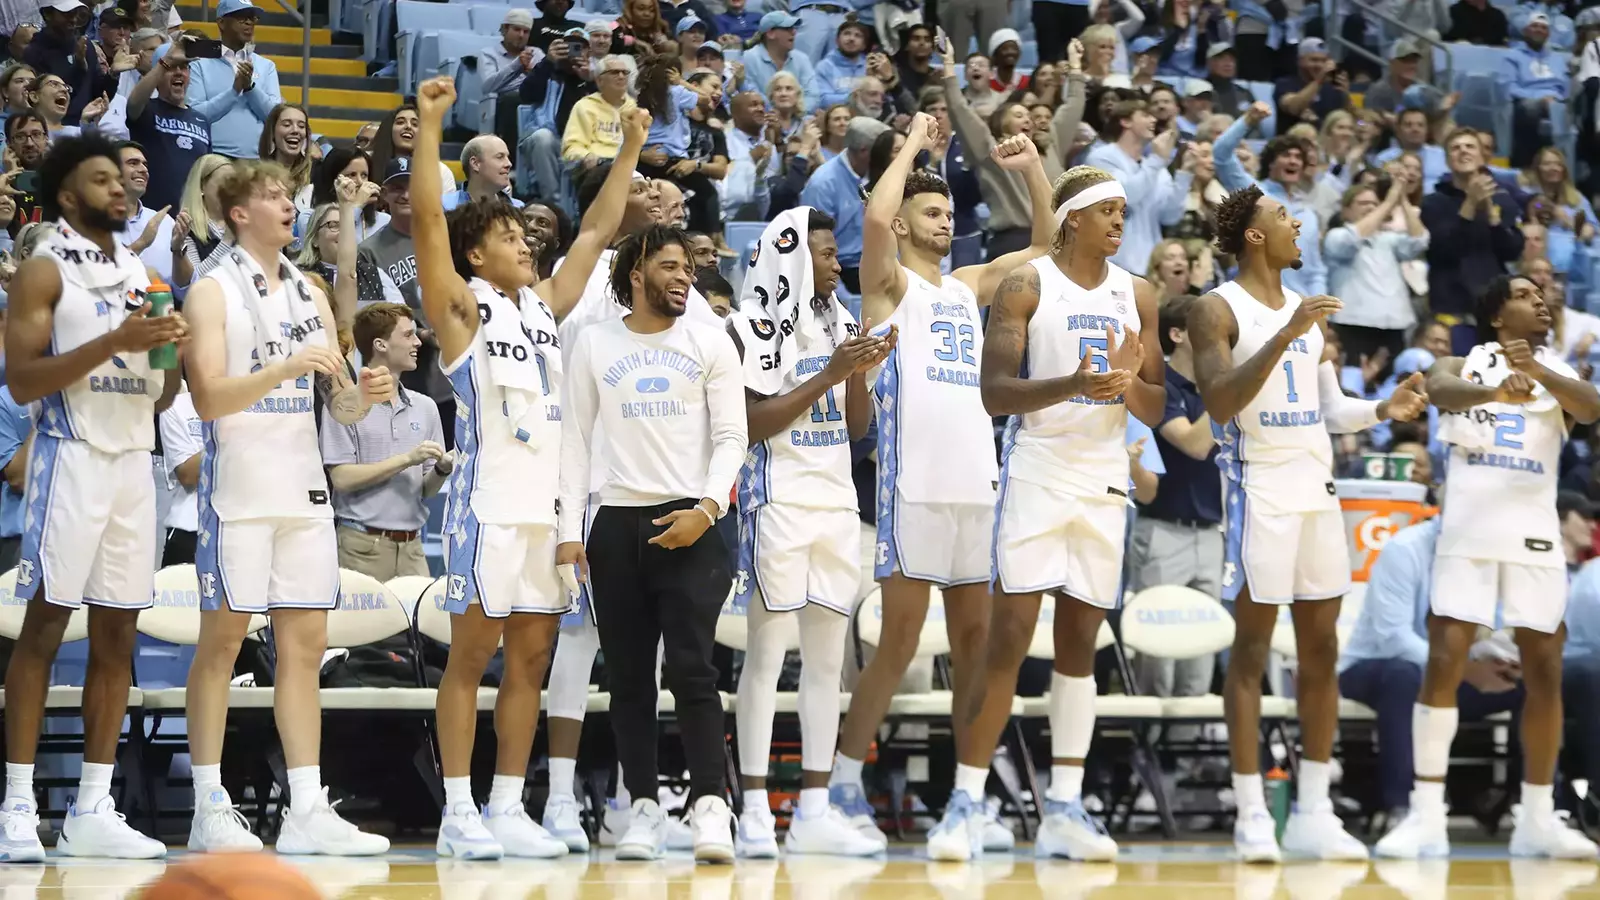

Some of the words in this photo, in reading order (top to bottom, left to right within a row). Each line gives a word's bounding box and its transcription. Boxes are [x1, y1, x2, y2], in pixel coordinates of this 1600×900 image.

[155, 114, 209, 140] CAROLINA
[1067, 314, 1120, 334] NORTH
[930, 321, 976, 367] 32
[1079, 337, 1109, 374] 5
[603, 351, 642, 388] NORTH
[643, 349, 705, 384] CAROLINA
[796, 355, 833, 377] NORT
[926, 366, 981, 388] CAROLIN
[1283, 361, 1298, 403] 1
[621, 400, 688, 418] BASKETBALL
[811, 386, 842, 423] 11
[1494, 412, 1526, 450] 2
[1467, 452, 1545, 475] CAROLINA
[1360, 515, 1392, 551] G
[154, 590, 199, 608] CARO
[1135, 608, 1221, 625] CAROLINA
